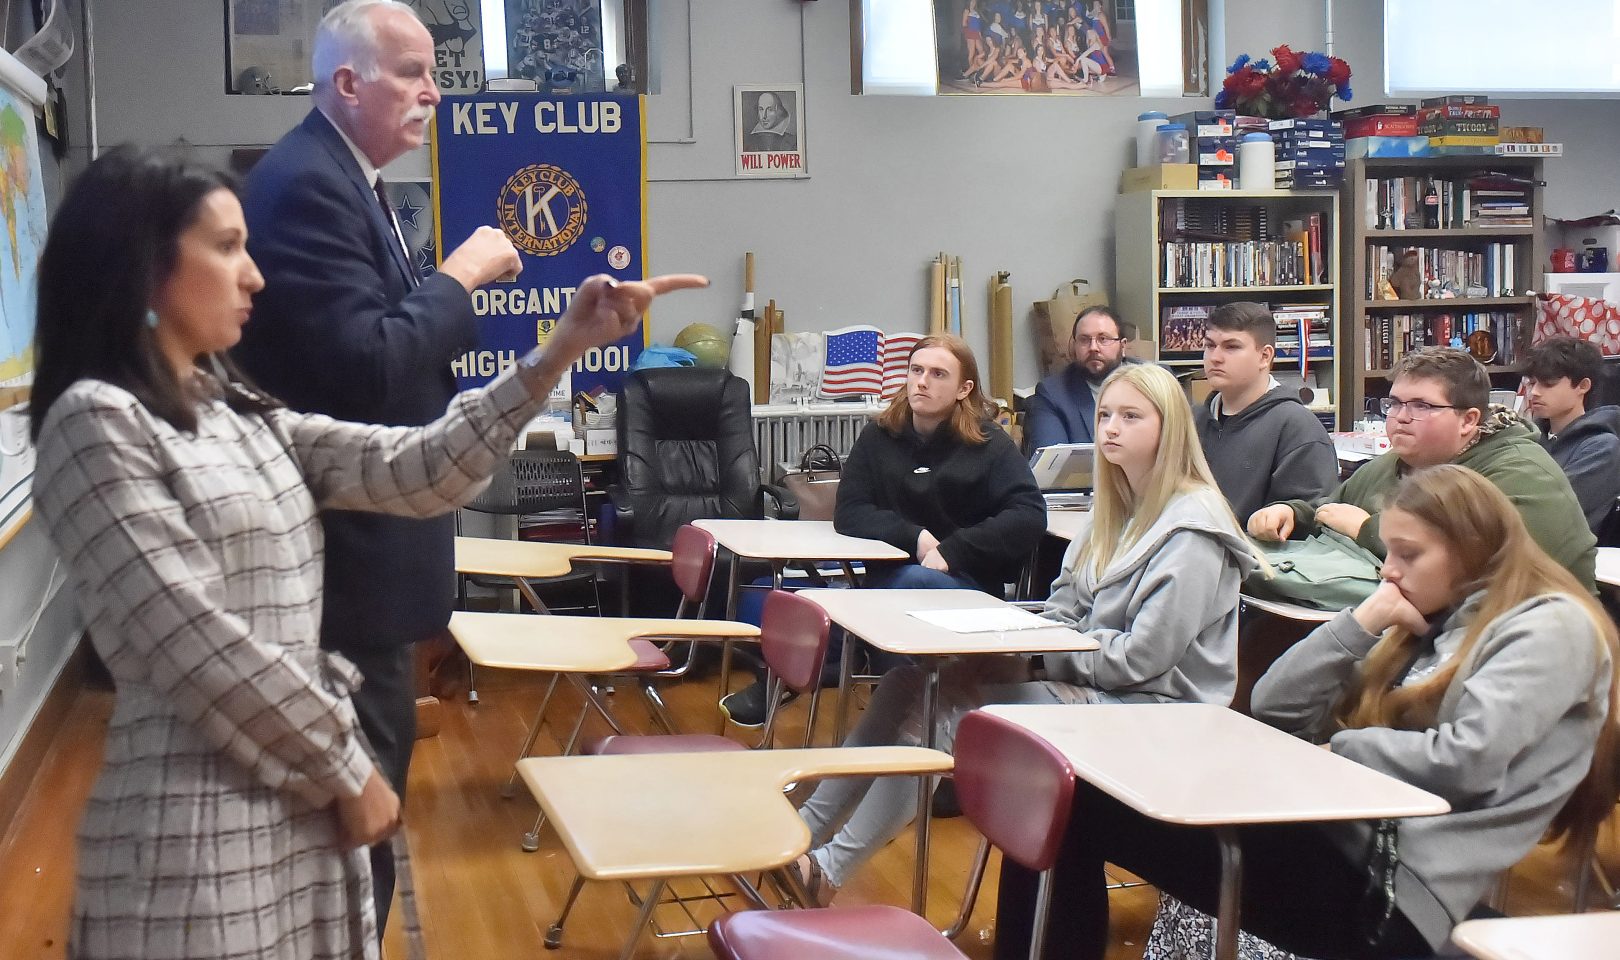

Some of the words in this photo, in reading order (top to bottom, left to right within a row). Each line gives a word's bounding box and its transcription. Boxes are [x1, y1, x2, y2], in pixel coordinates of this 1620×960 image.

[435, 50, 465, 67] ET
[453, 102, 518, 134] KEY
[535, 102, 621, 134] CLUB
[741, 154, 763, 170] WILL
[767, 153, 801, 169] POWER
[505, 203, 581, 250] INTERNATIONAL
[471, 287, 577, 316] ORGANT
[451, 350, 515, 377] HIGH
